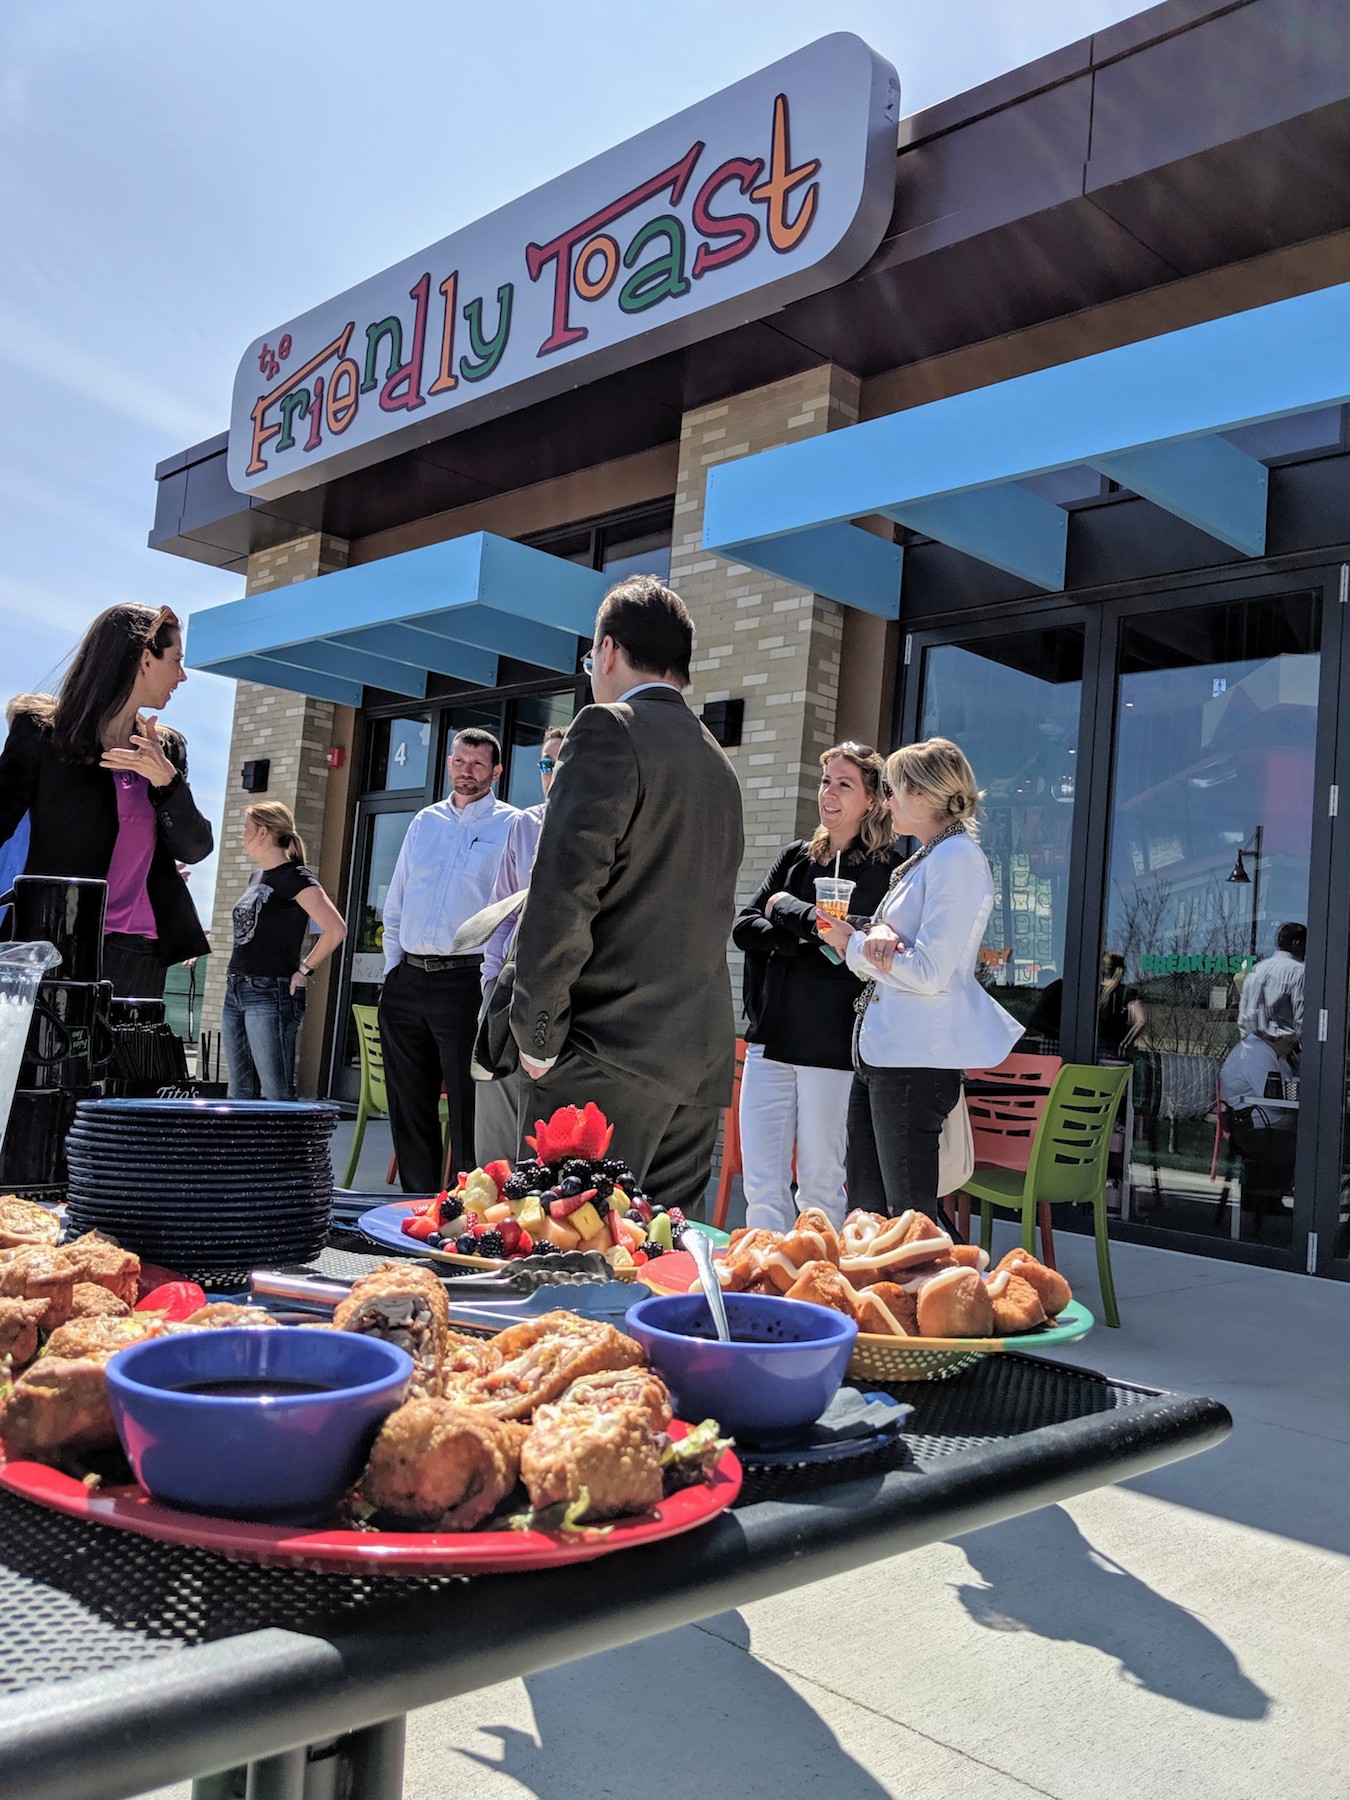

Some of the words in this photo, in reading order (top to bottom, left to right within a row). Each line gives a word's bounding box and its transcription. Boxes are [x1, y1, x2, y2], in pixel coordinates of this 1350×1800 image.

[246, 269, 513, 477] Friendly
[526, 93, 821, 358] Toast
[258, 333, 292, 381] the
[394, 742, 406, 766] 4
[1141, 953, 1257, 974] BREAKFAST
